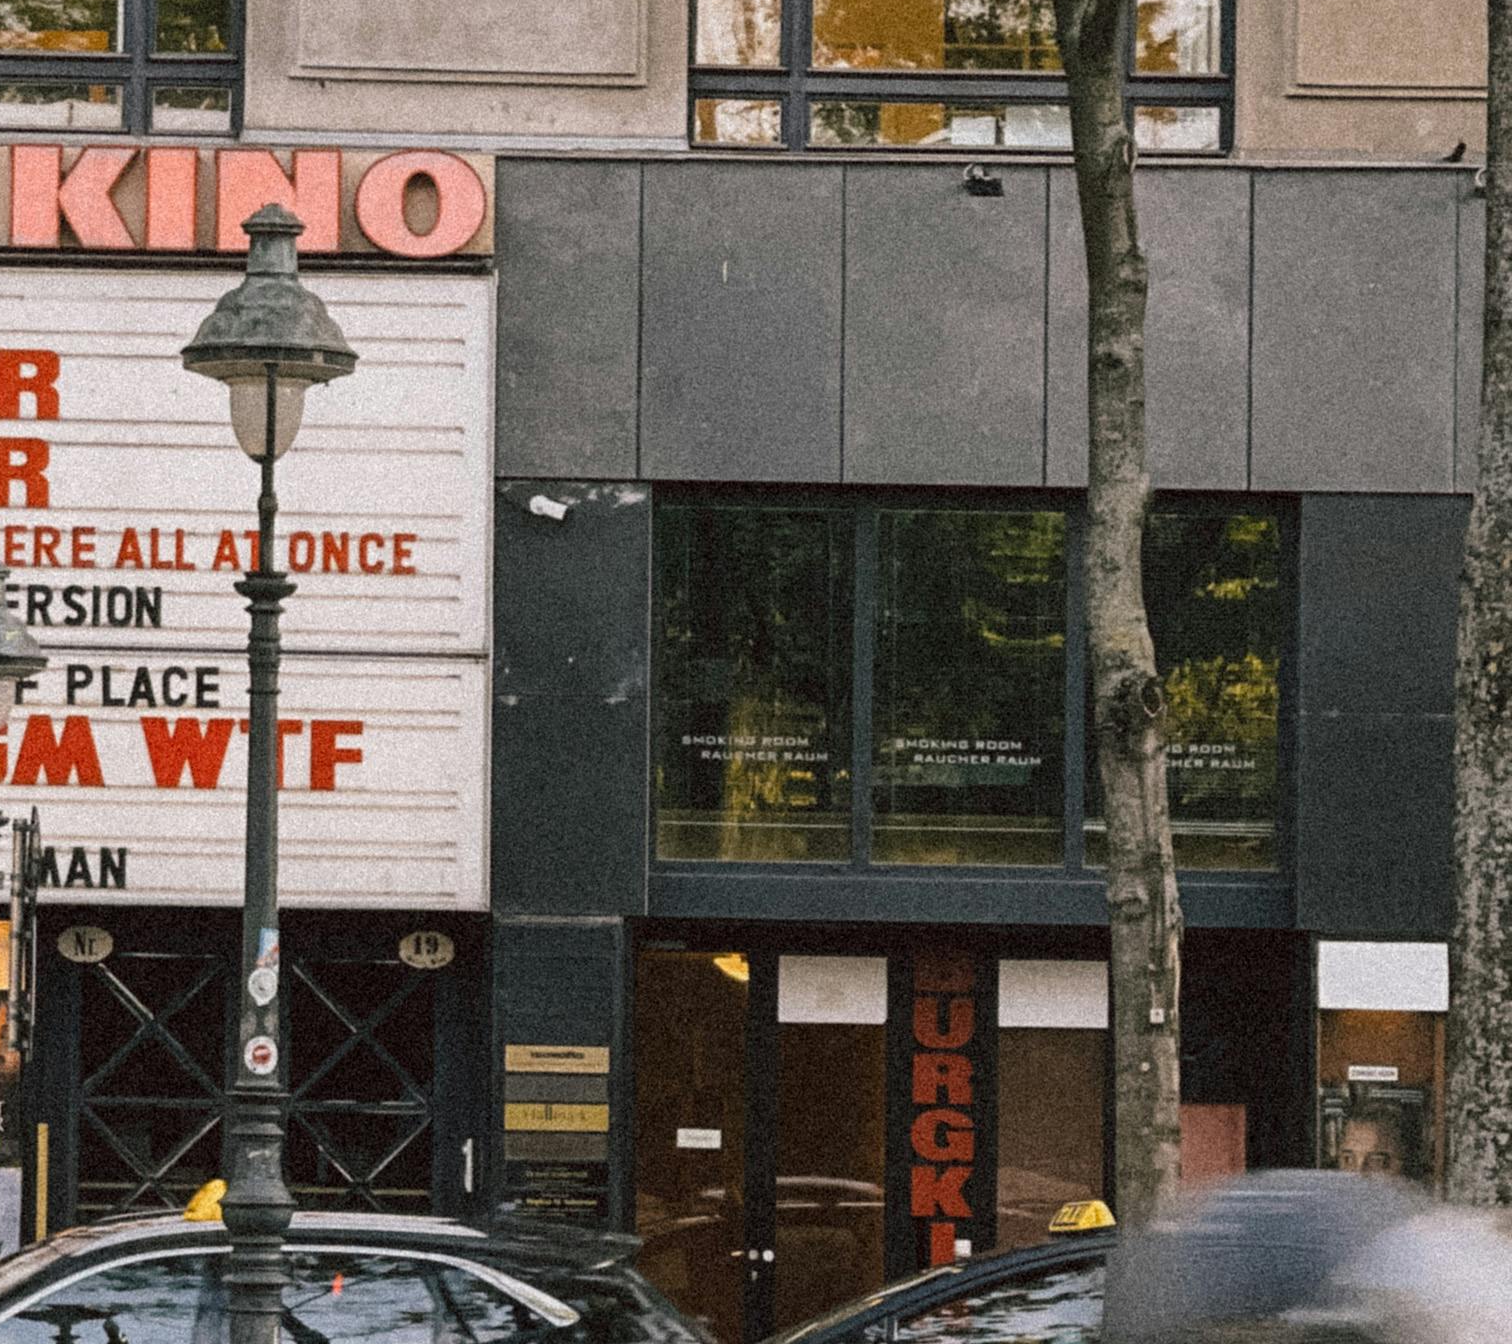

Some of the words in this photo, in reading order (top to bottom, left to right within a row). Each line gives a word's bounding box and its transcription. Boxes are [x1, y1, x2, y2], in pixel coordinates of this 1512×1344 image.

[10, 144, 487, 258] KINO
[115, 527, 196, 571] ALL
[288, 531, 417, 575] ONCE
[66, 664, 220, 709] PLACE
[783, 752, 828, 762] RAUM
[895, 738, 969, 750] SMOKING
[975, 739, 1022, 751] ROOM
[913, 753, 990, 766] RAUCHER
[996, 755, 1041, 767] RAUM
